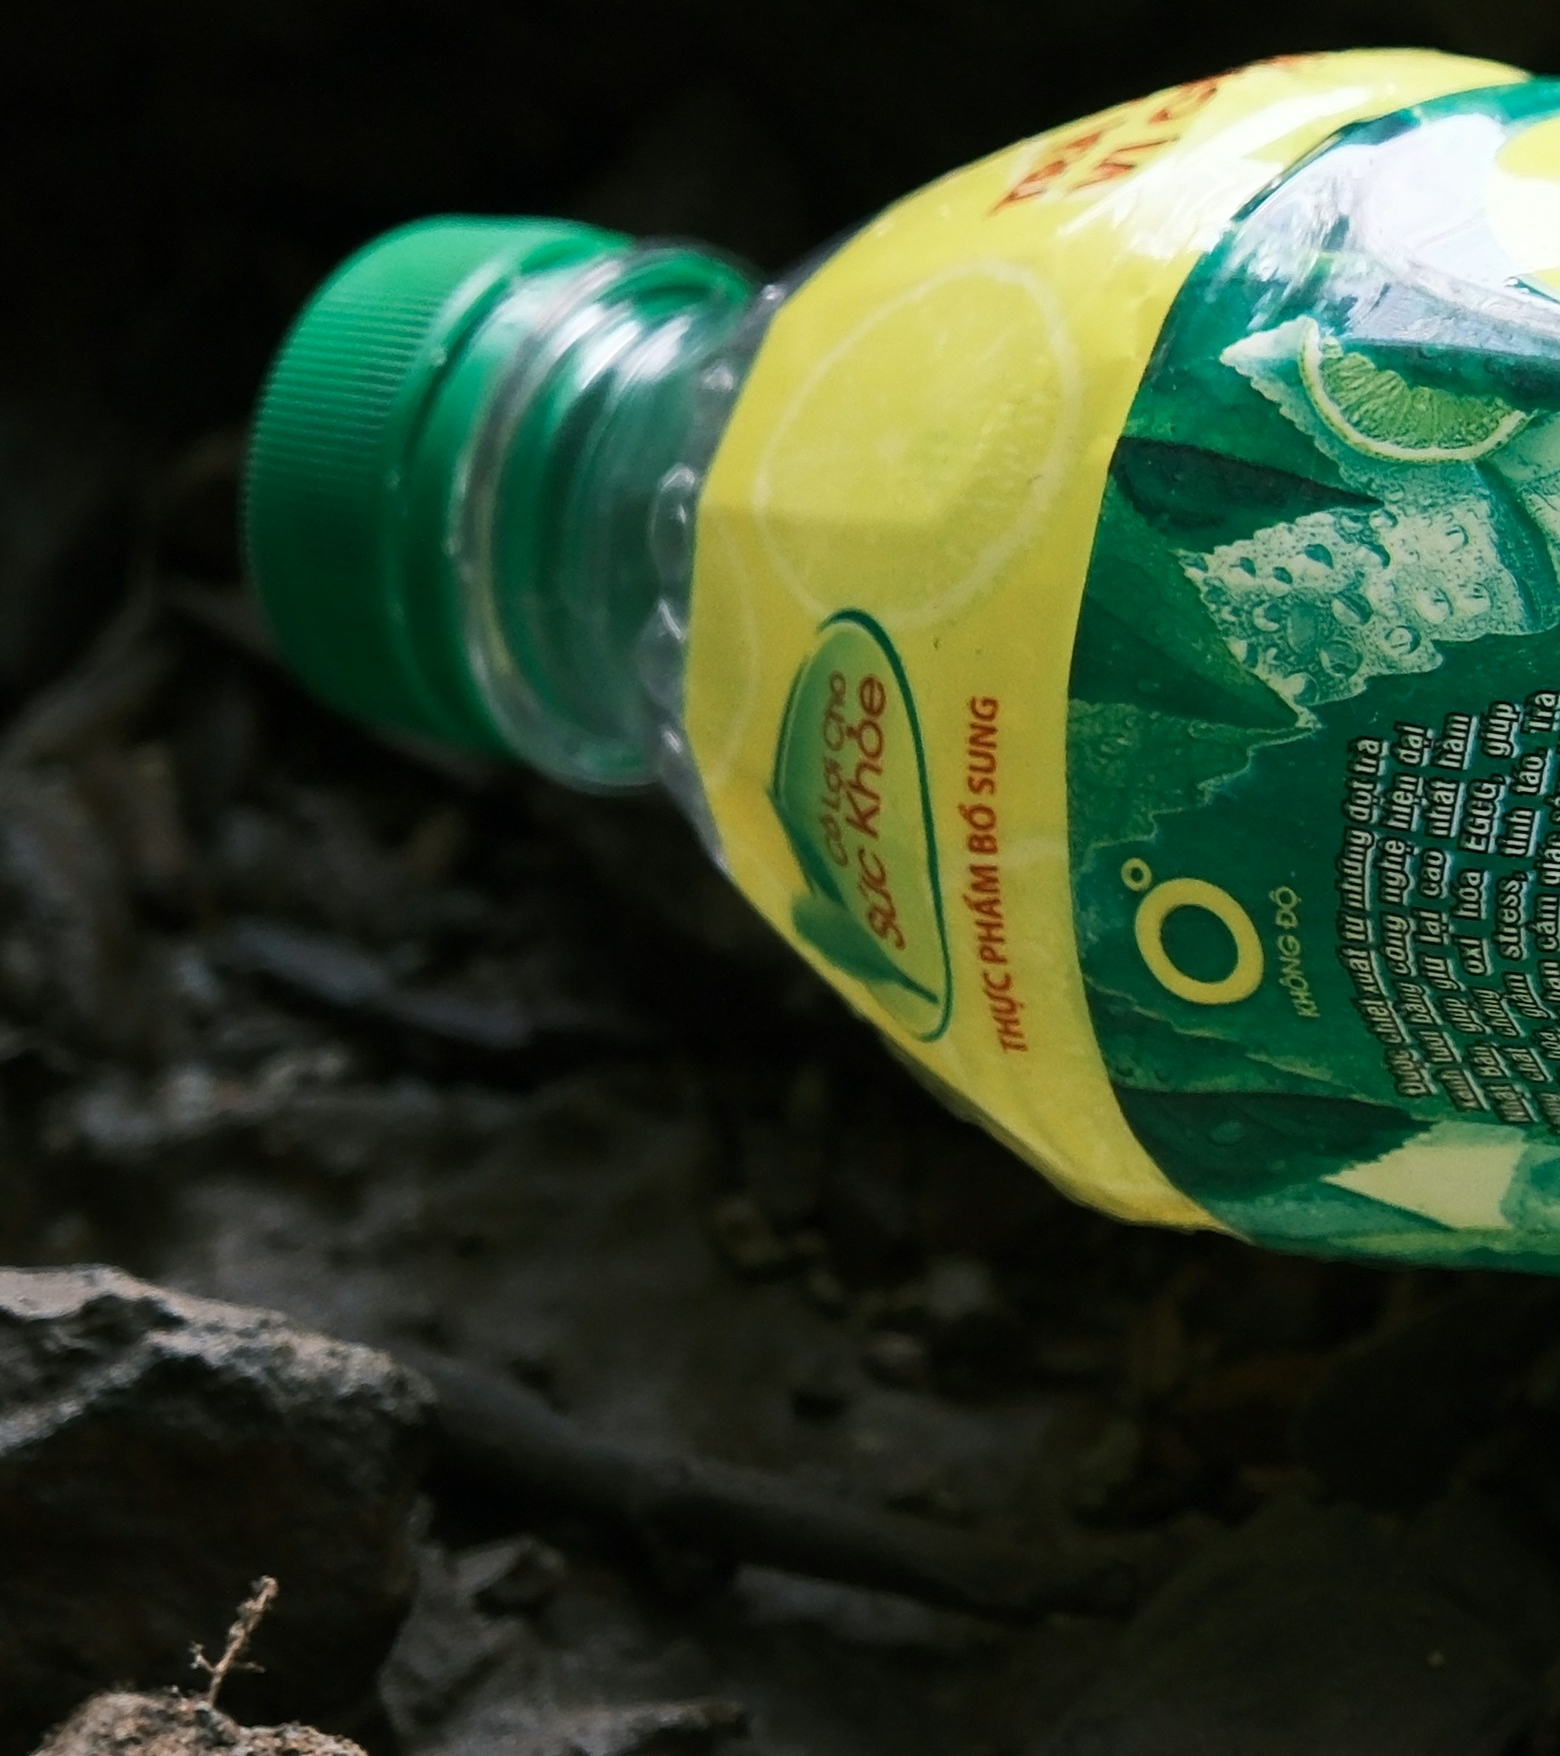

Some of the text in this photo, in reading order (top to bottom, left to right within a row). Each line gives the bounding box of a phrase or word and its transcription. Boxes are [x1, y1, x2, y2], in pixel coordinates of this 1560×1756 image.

[811, 665, 847, 753] Cho
[1431, 709, 1470, 769] hàm
[1476, 698, 1518, 758] giúp
[1346, 734, 1380, 774] trà
[1390, 721, 1430, 766] đại
[839, 668, 904, 950] Sức Khỏe
[1380, 770, 1424, 831] hiện
[1418, 775, 1458, 837] nhất
[1457, 769, 1504, 853] EGCG,
[1494, 864, 1526, 957] stress,
[1519, 686, 1557, 737] Trà
[964, 690, 1026, 1057] THỰC PHẨM BỔ SUNG
[1337, 828, 1373, 908] những
[1373, 837, 1413, 904] nghệ
[1417, 847, 1443, 897] cao
[1448, 865, 1483, 918] hóa
[1269, 883, 1319, 1019] KHÔNG ĐỘ
[1385, 912, 1411, 975] công
[1411, 907, 1444, 945] lại
[1529, 890, 1559, 952] cảm
[1458, 935, 1484, 977] oxi
